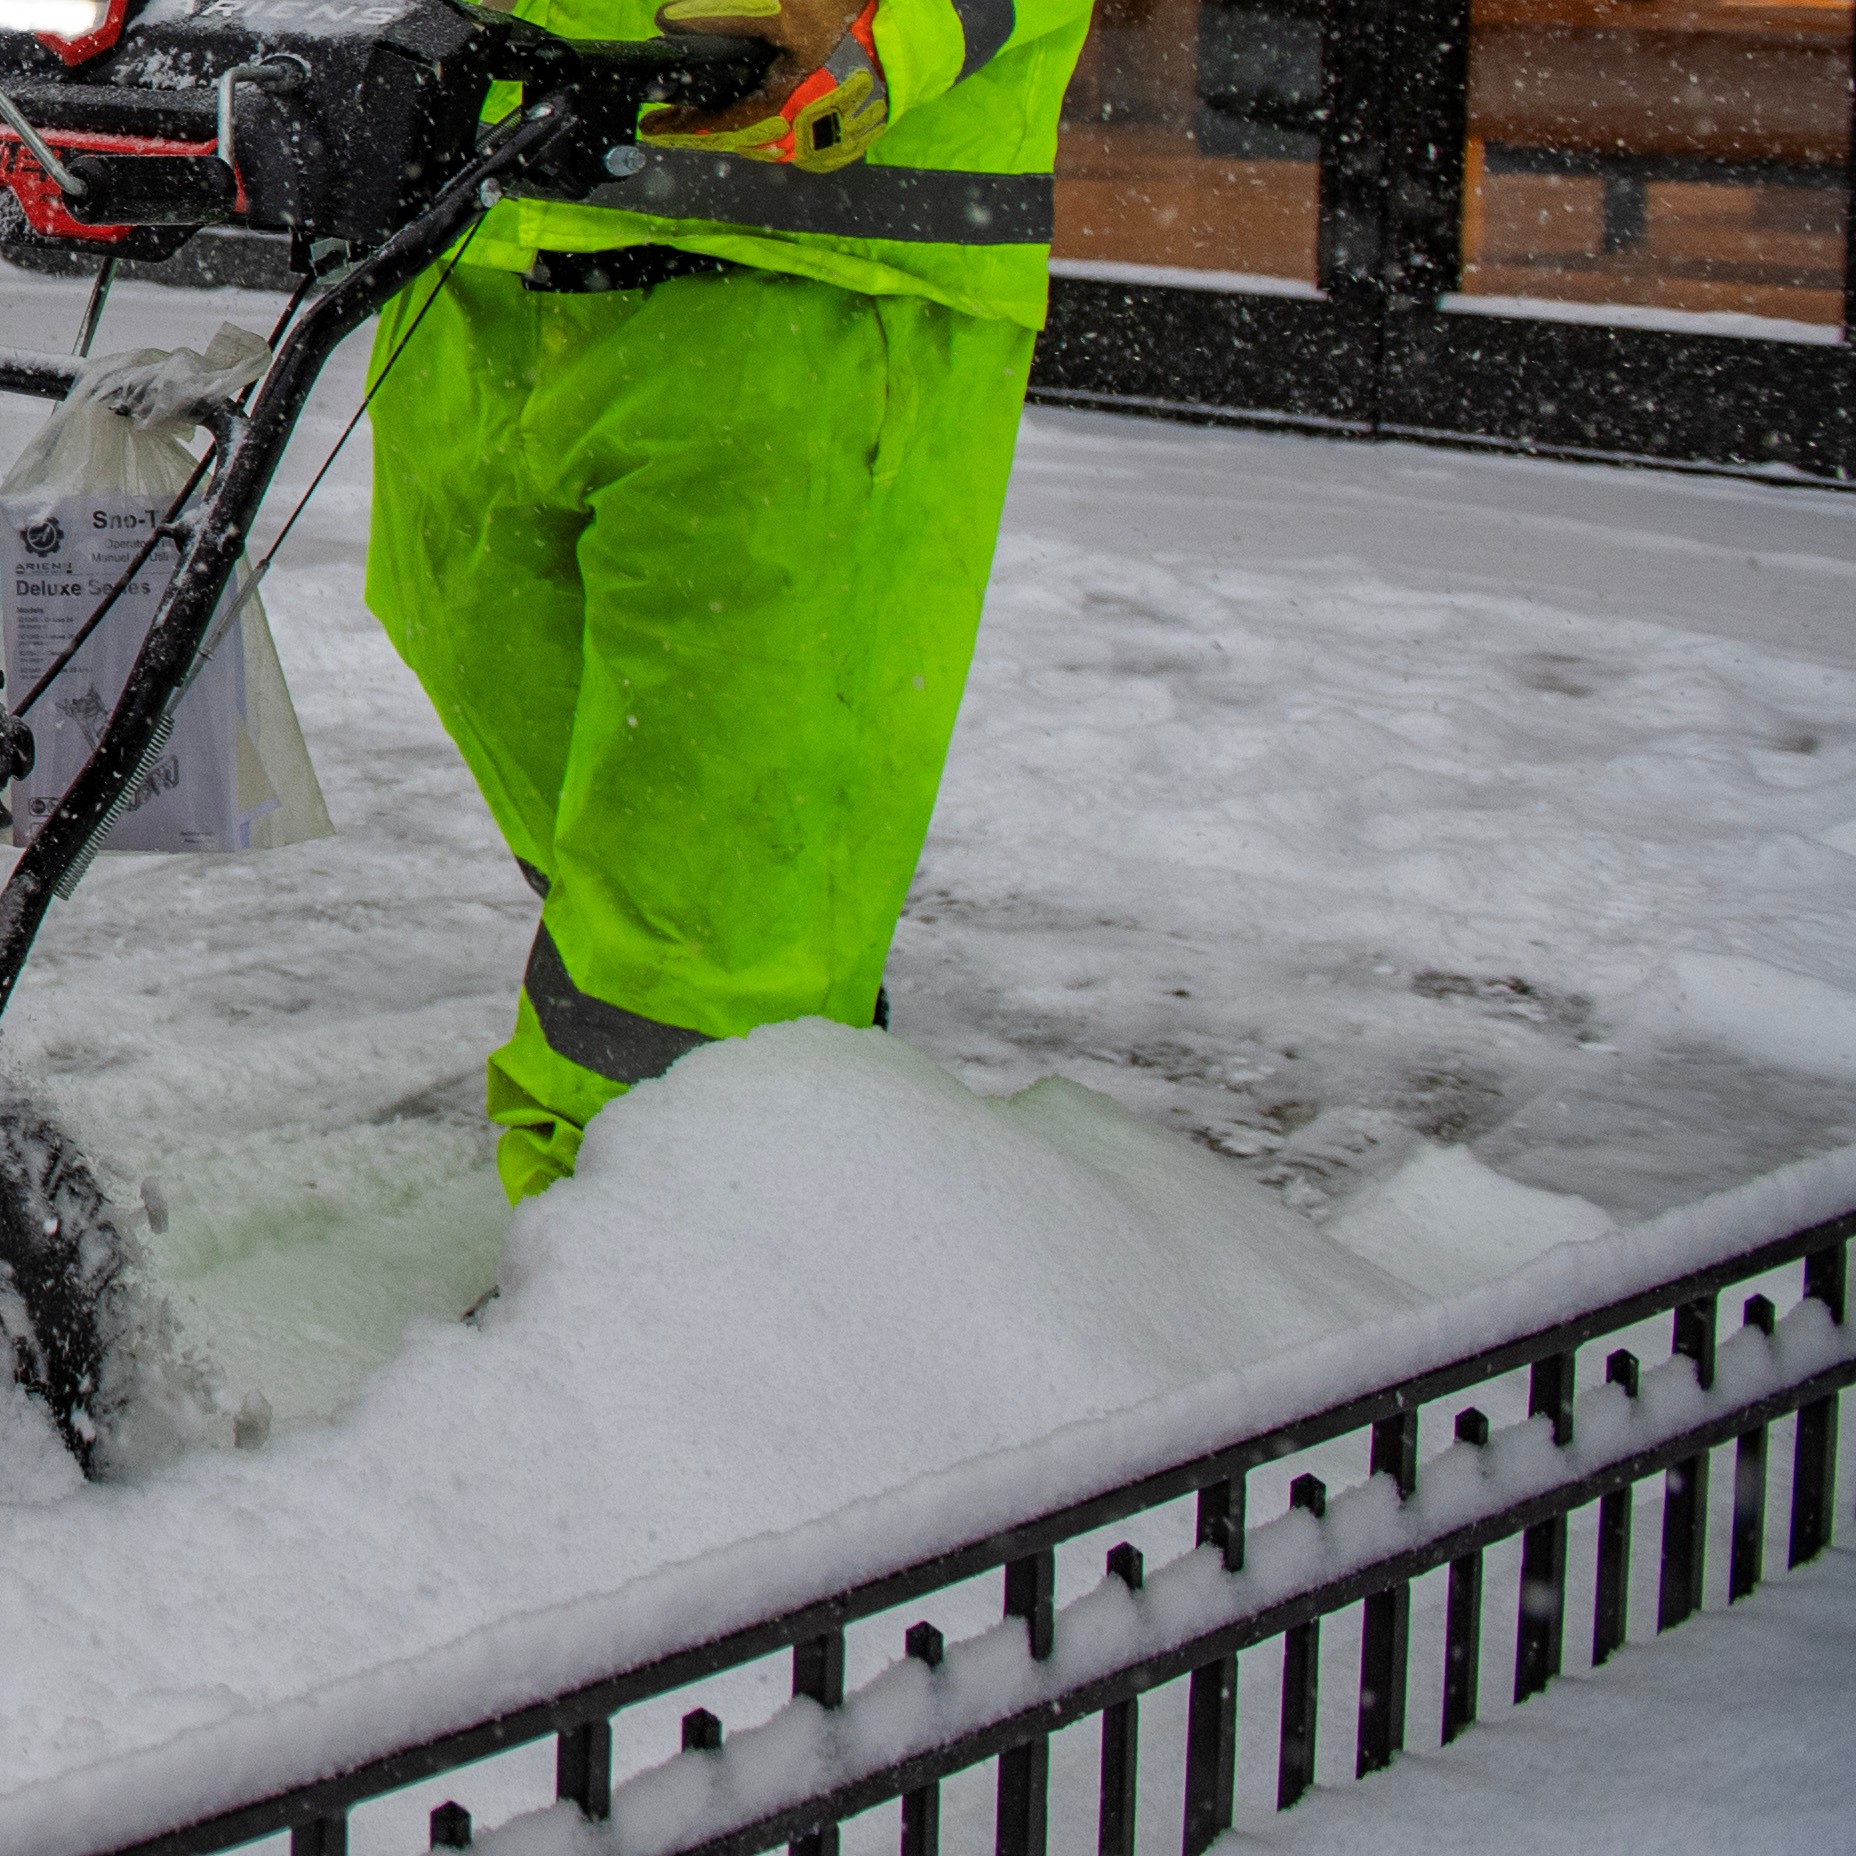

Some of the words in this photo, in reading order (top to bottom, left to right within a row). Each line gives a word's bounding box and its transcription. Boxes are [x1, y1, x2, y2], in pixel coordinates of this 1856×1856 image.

[92, 509, 160, 530] Sno-T
[16, 580, 81, 596] Deluxe
[88, 580, 151, 596] Sees
